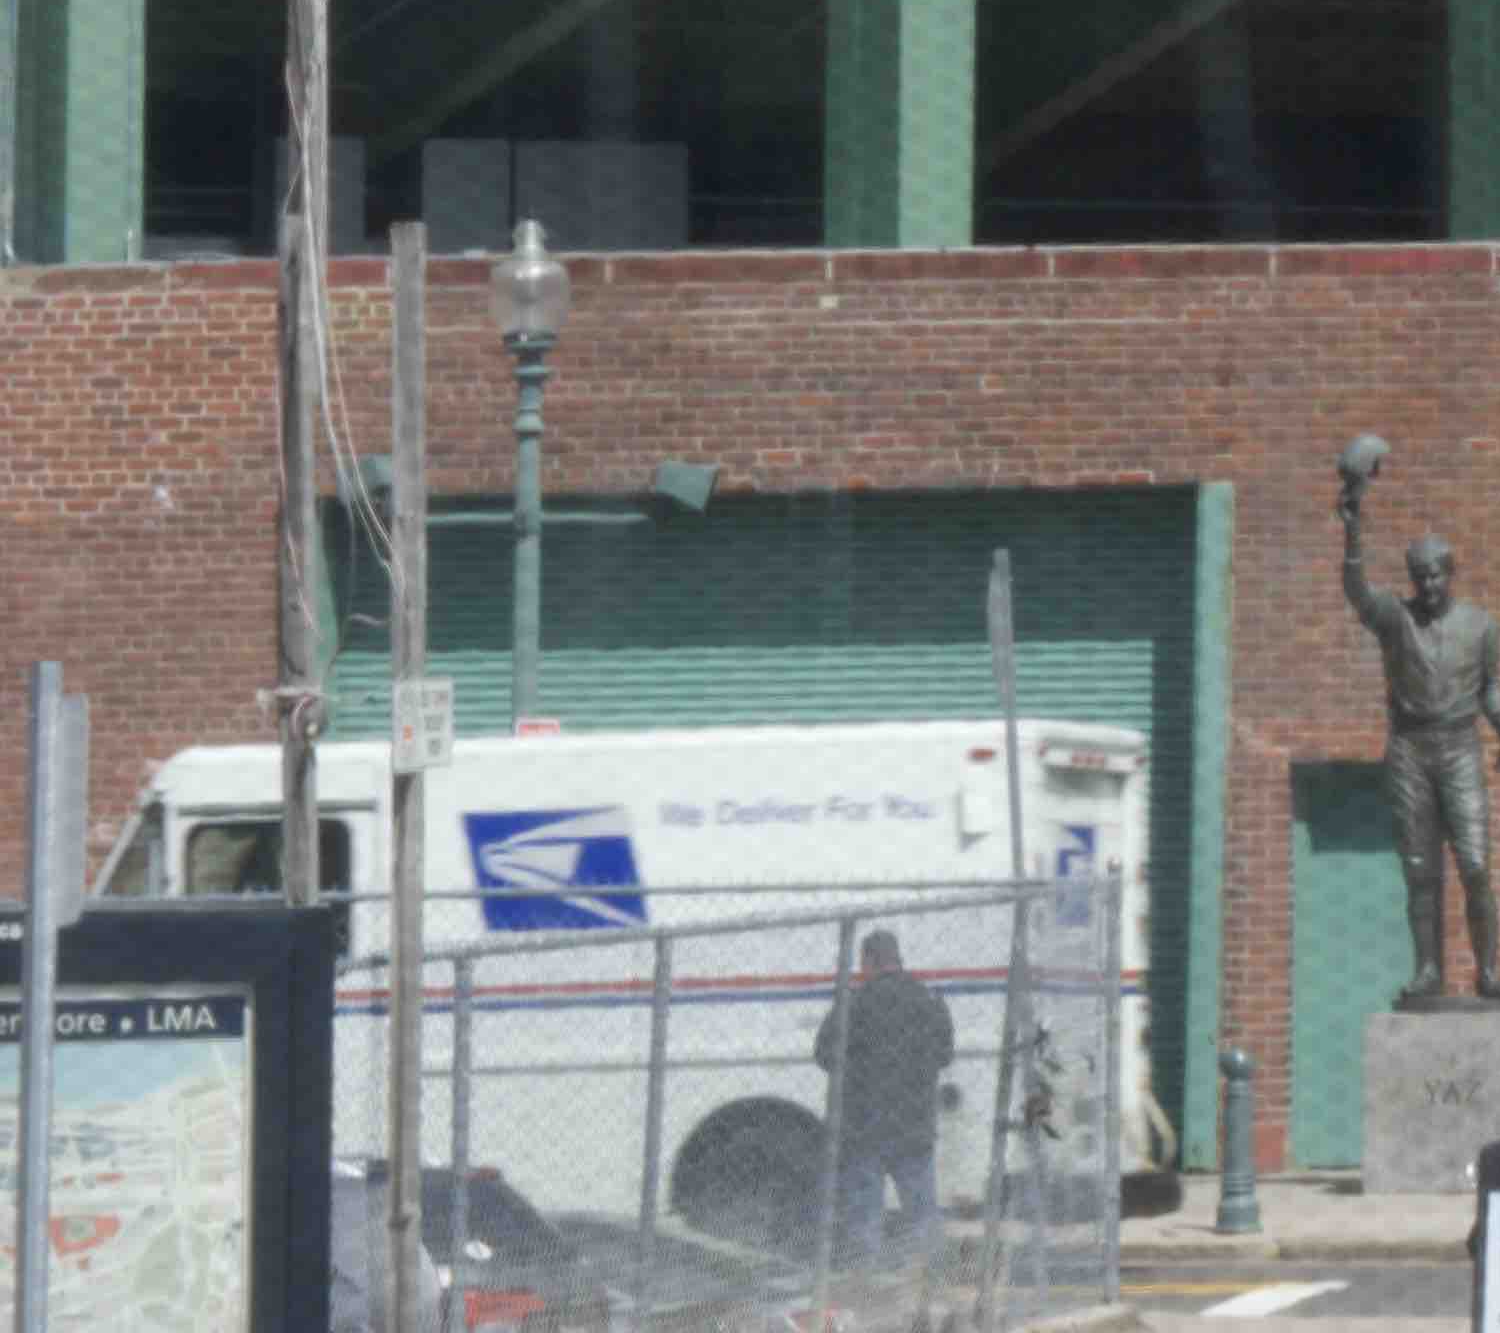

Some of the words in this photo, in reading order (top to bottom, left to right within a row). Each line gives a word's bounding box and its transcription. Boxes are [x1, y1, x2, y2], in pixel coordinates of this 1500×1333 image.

[823, 794, 875, 821] For
[880, 791, 936, 820] You
[146, 1004, 217, 1032] LMA
[1423, 1079, 1482, 1106] YAZ
